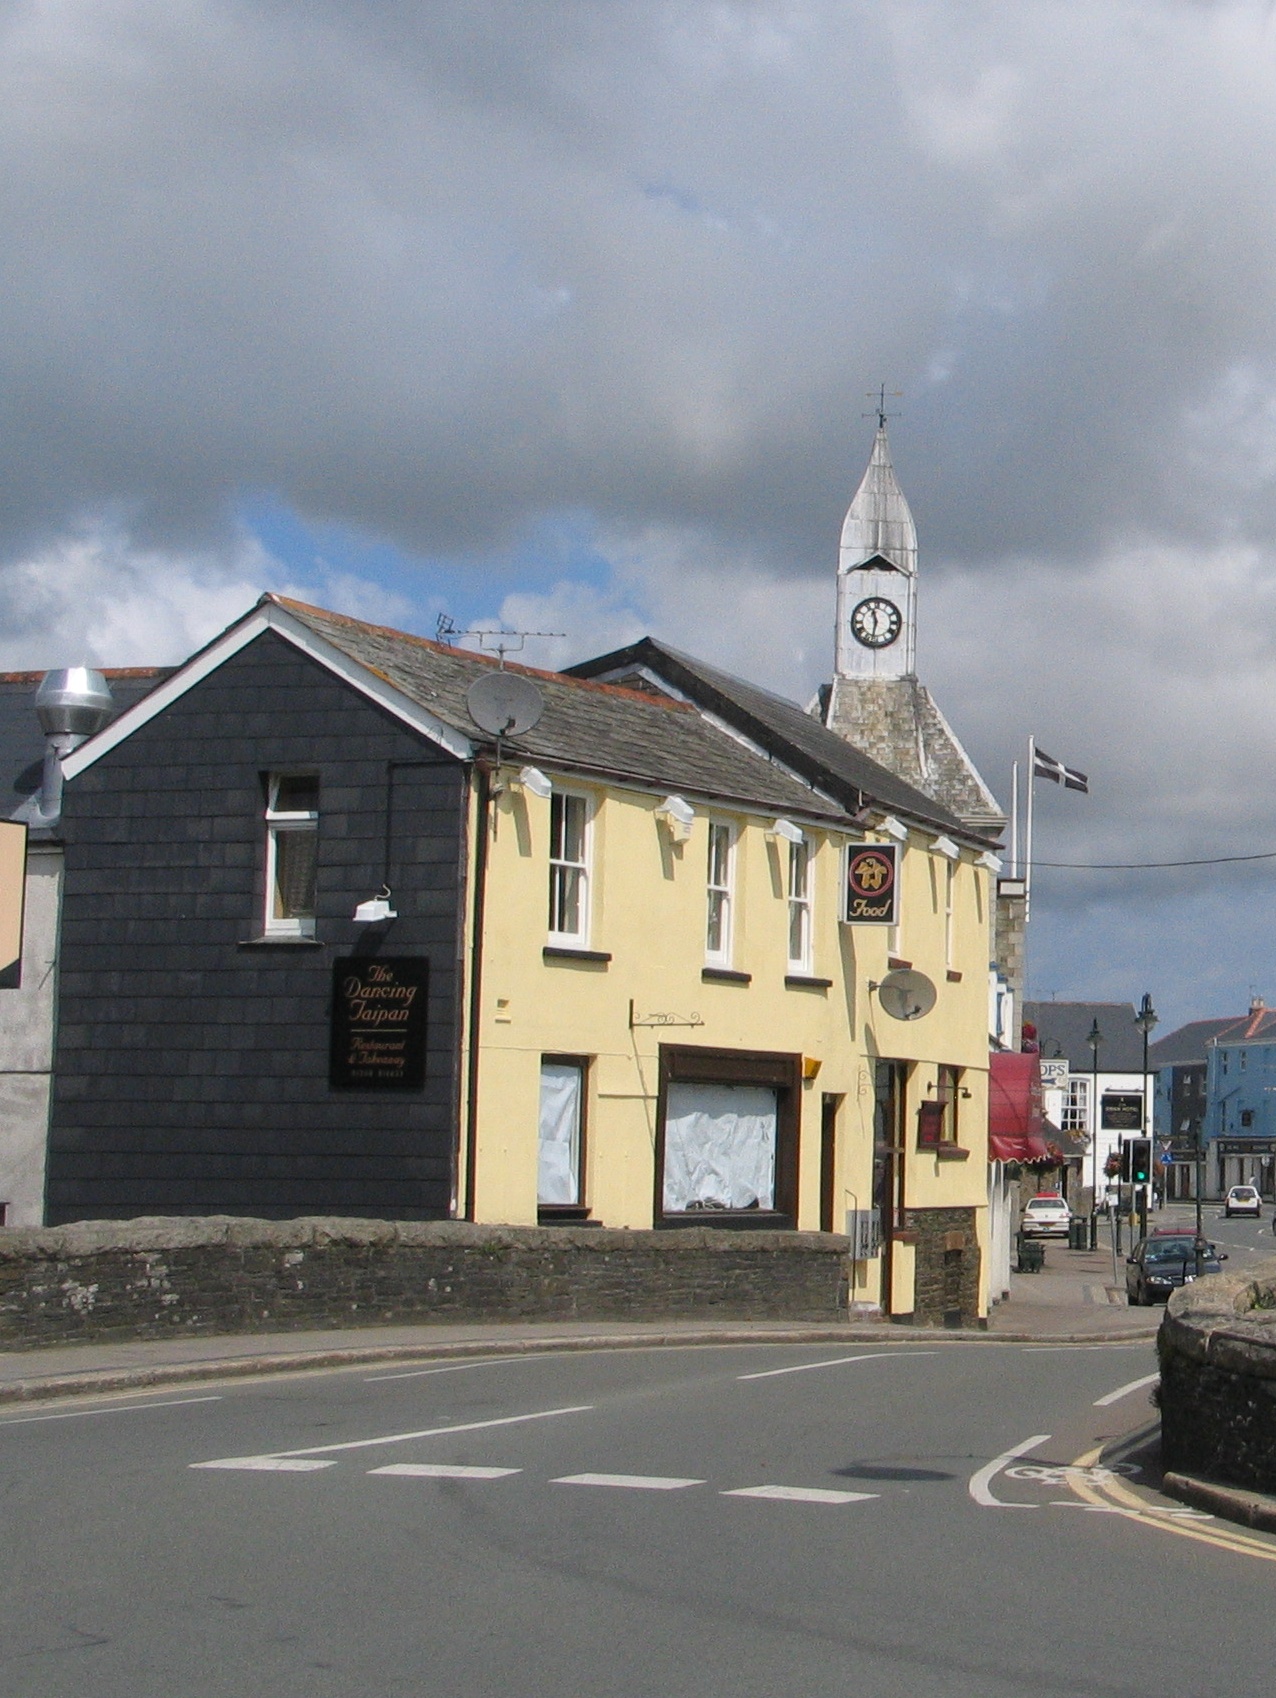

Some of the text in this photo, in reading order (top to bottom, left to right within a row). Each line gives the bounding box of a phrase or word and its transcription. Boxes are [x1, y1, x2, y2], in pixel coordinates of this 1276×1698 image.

[850, 898, 892, 917] Food
[369, 965, 394, 982] The
[344, 976, 418, 1007] Dancing
[350, 999, 409, 1026] Taipan
